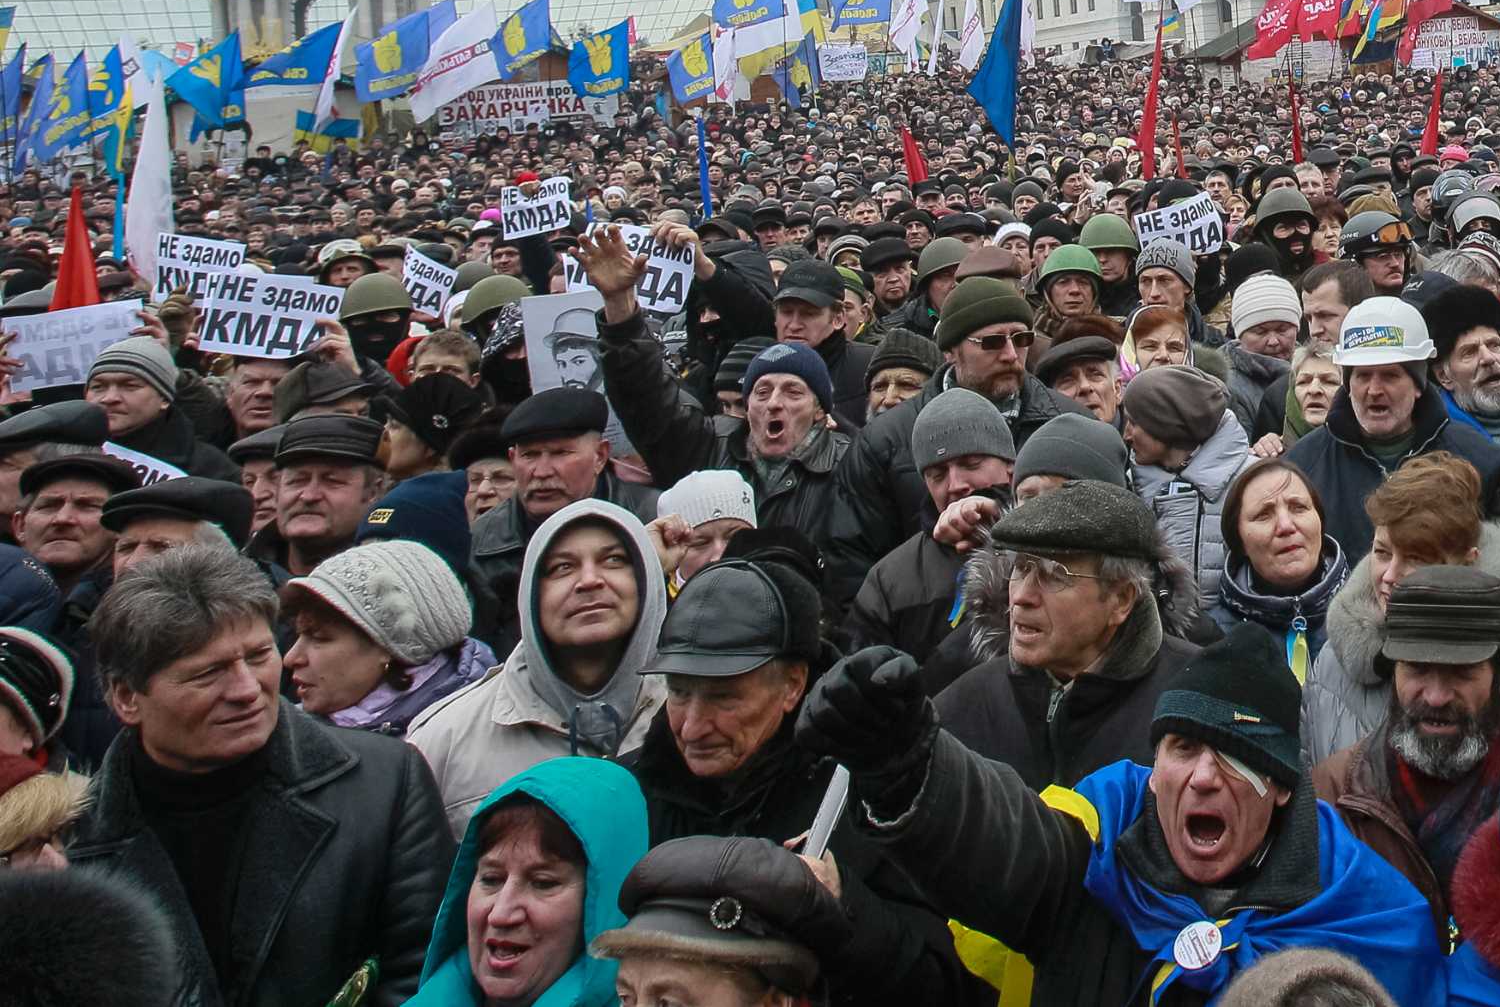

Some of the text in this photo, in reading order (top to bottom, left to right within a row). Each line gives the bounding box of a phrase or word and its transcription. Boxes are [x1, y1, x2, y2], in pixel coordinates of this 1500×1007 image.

[453, 85, 576, 105] АРОД УКРАЇНИ прот
[503, 200, 570, 234] КМДА
[1138, 198, 1214, 234] НЕ здамо
[159, 234, 241, 269] НЕ здамо
[410, 258, 454, 287] здамо
[219, 274, 340, 315] НЕ здамо
